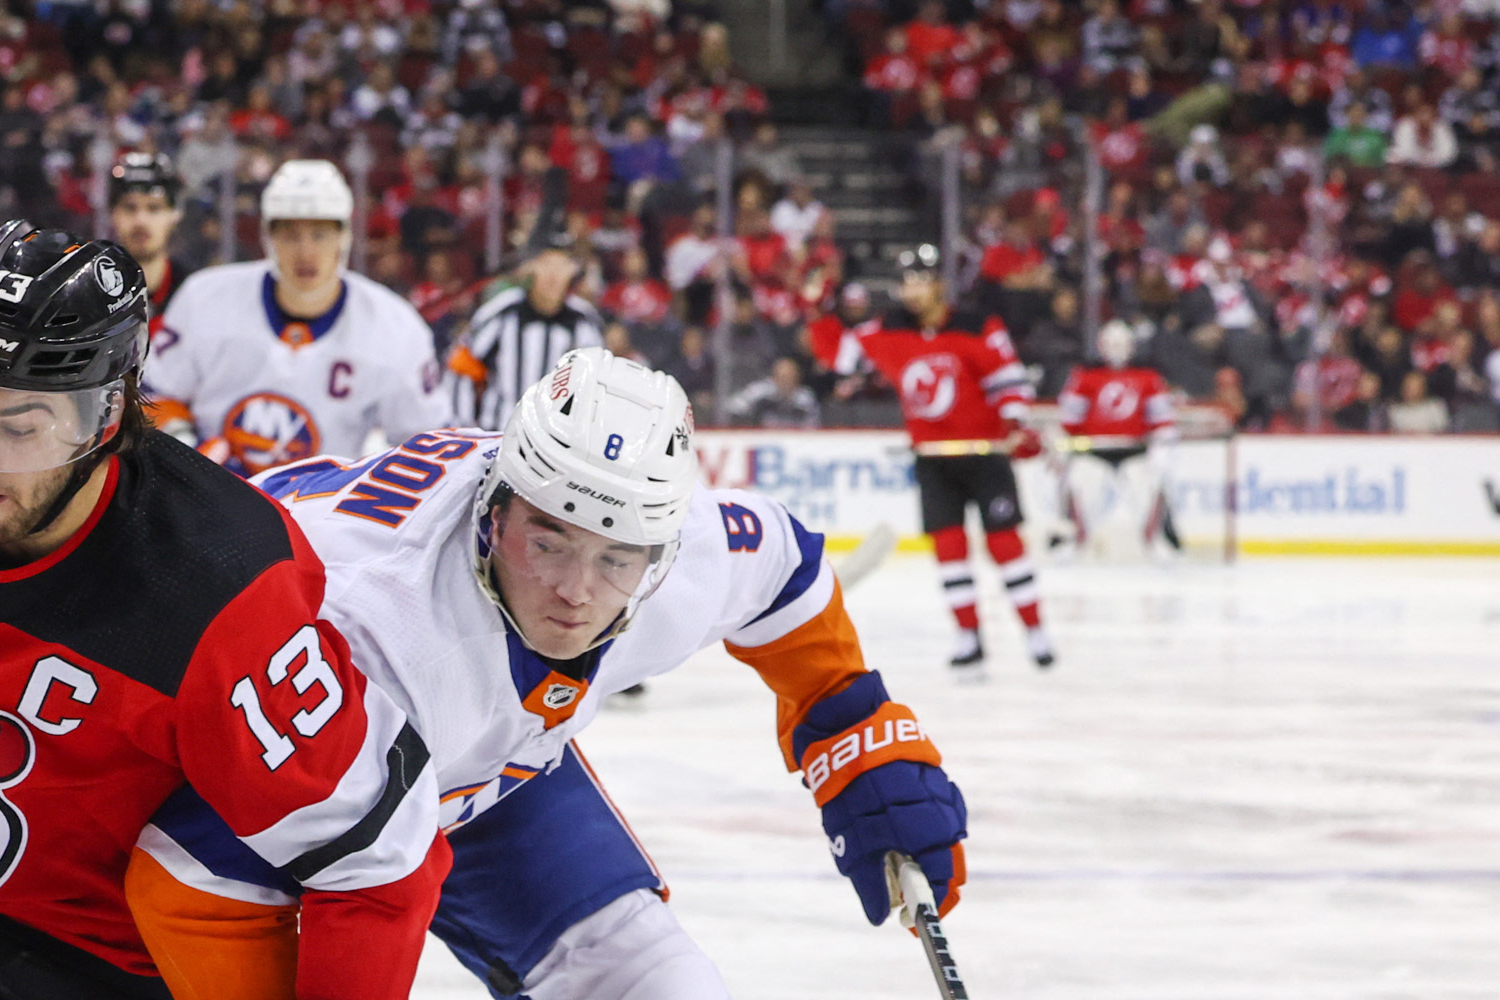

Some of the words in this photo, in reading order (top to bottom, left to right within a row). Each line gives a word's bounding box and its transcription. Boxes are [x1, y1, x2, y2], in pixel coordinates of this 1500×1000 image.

[327, 361, 352, 399] C
[549, 365, 574, 401] URS
[603, 433, 625, 461] 8
[333, 431, 478, 529] SON
[1175, 467, 1406, 515] rudential
[717, 501, 763, 553] 8
[16, 654, 99, 736] C
[230, 623, 343, 771] 13
